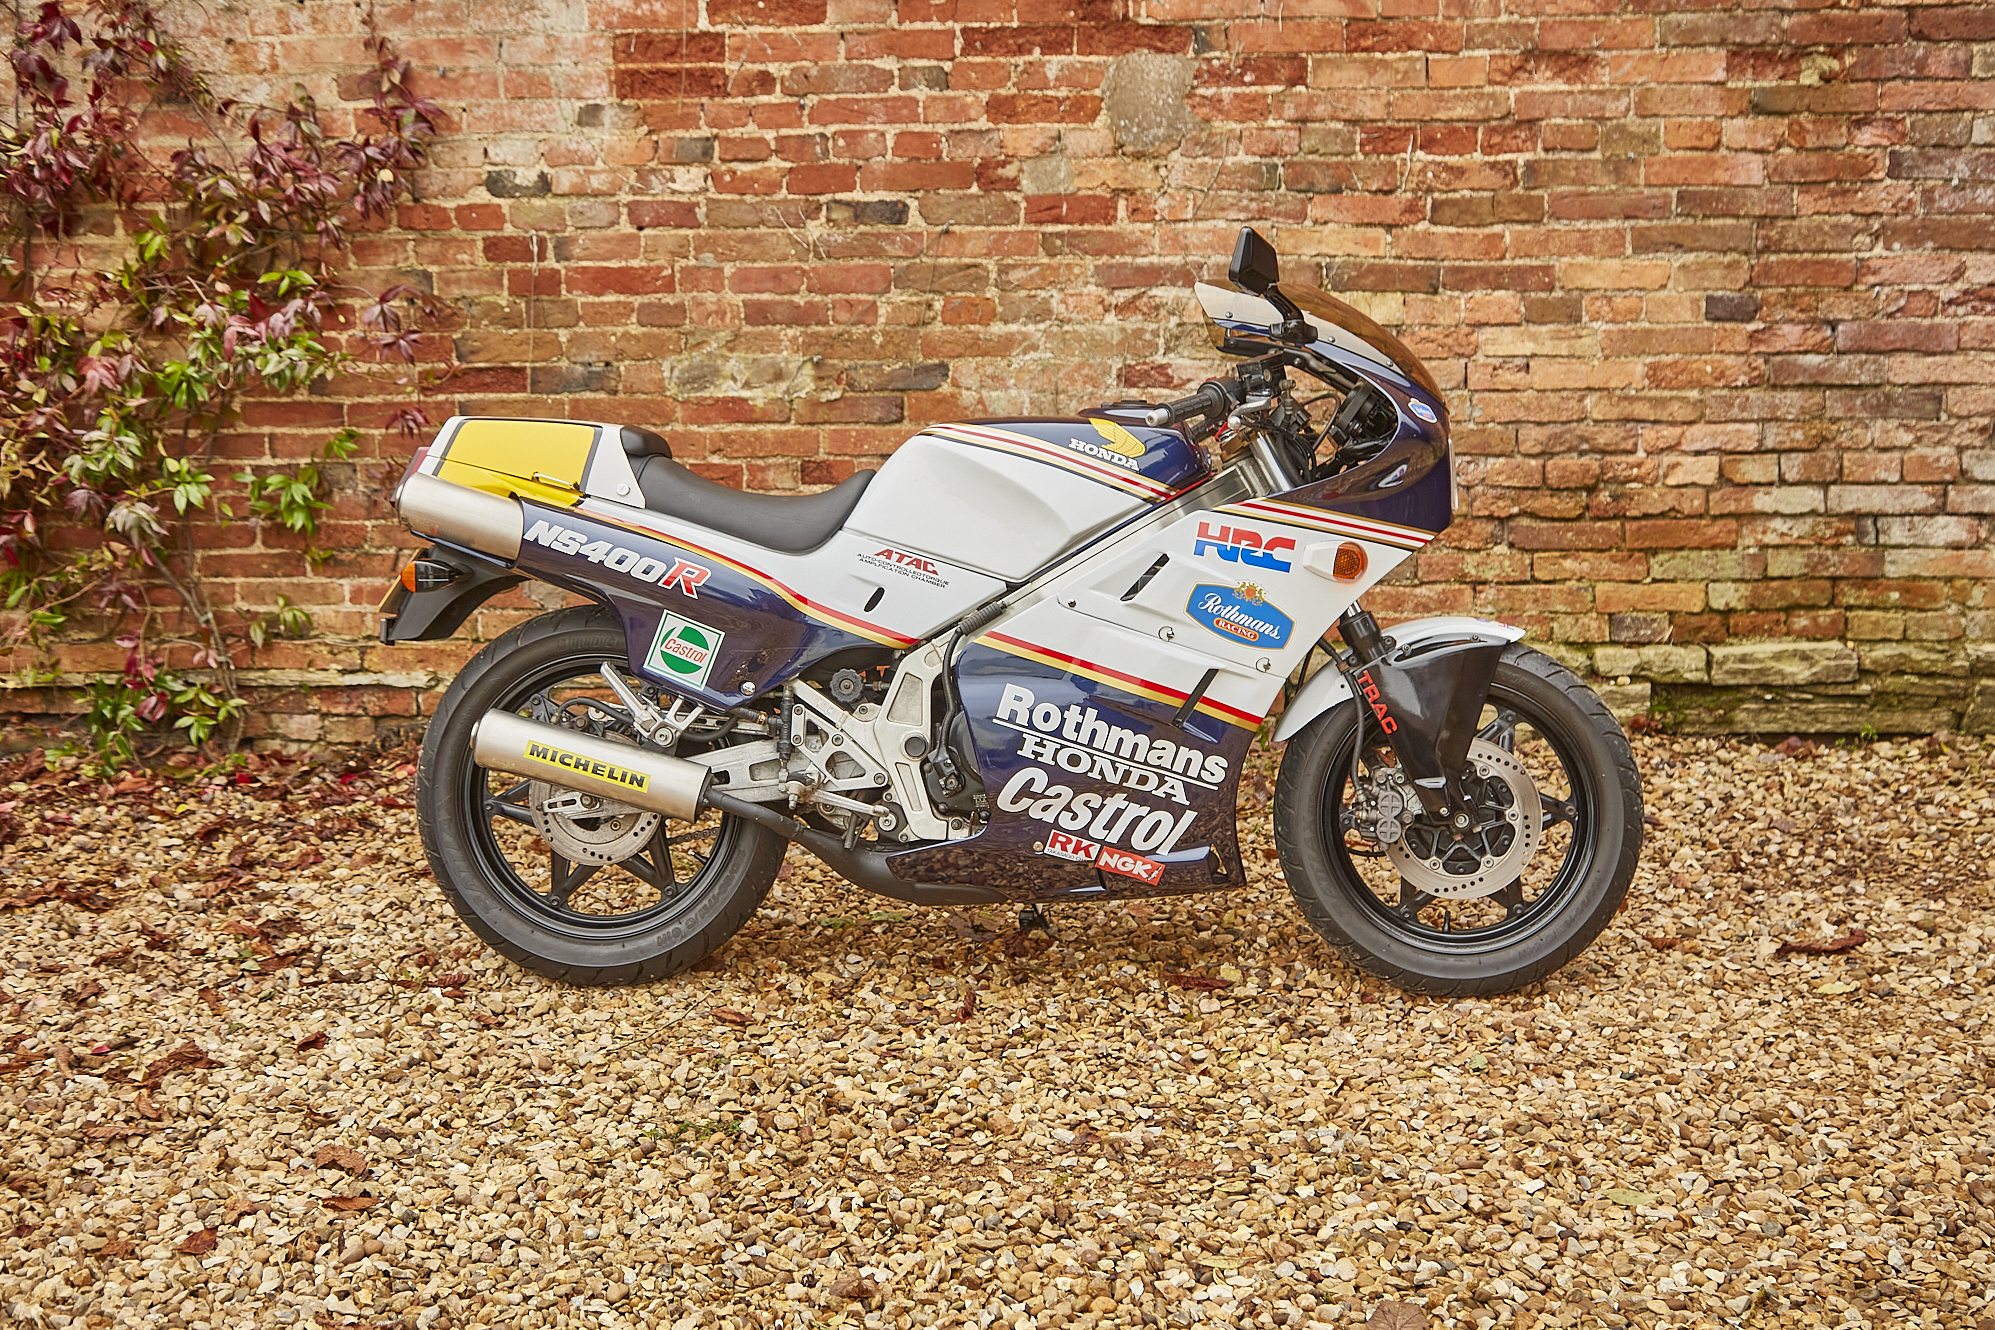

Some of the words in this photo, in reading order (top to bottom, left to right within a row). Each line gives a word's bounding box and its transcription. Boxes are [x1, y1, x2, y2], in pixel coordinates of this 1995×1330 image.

[1068, 438, 1140, 471] HONDA
[523, 519, 712, 599] NS400R
[873, 548, 939, 576] ATAC
[1194, 521, 1297, 573] HRC
[911, 575, 946, 589] CHAMBER
[1198, 593, 1281, 639] Rothmans
[1218, 620, 1255, 639] RACING
[664, 638, 707, 664] Castrol
[1358, 670, 1398, 735] TRAC
[996, 682, 1229, 784] Rothmans
[529, 744, 645, 788] MICHELIN
[1017, 733, 1190, 806] HONDA
[997, 767, 1198, 856] Castrol
[1048, 831, 1096, 860] RK
[1098, 851, 1152, 879] NGK
